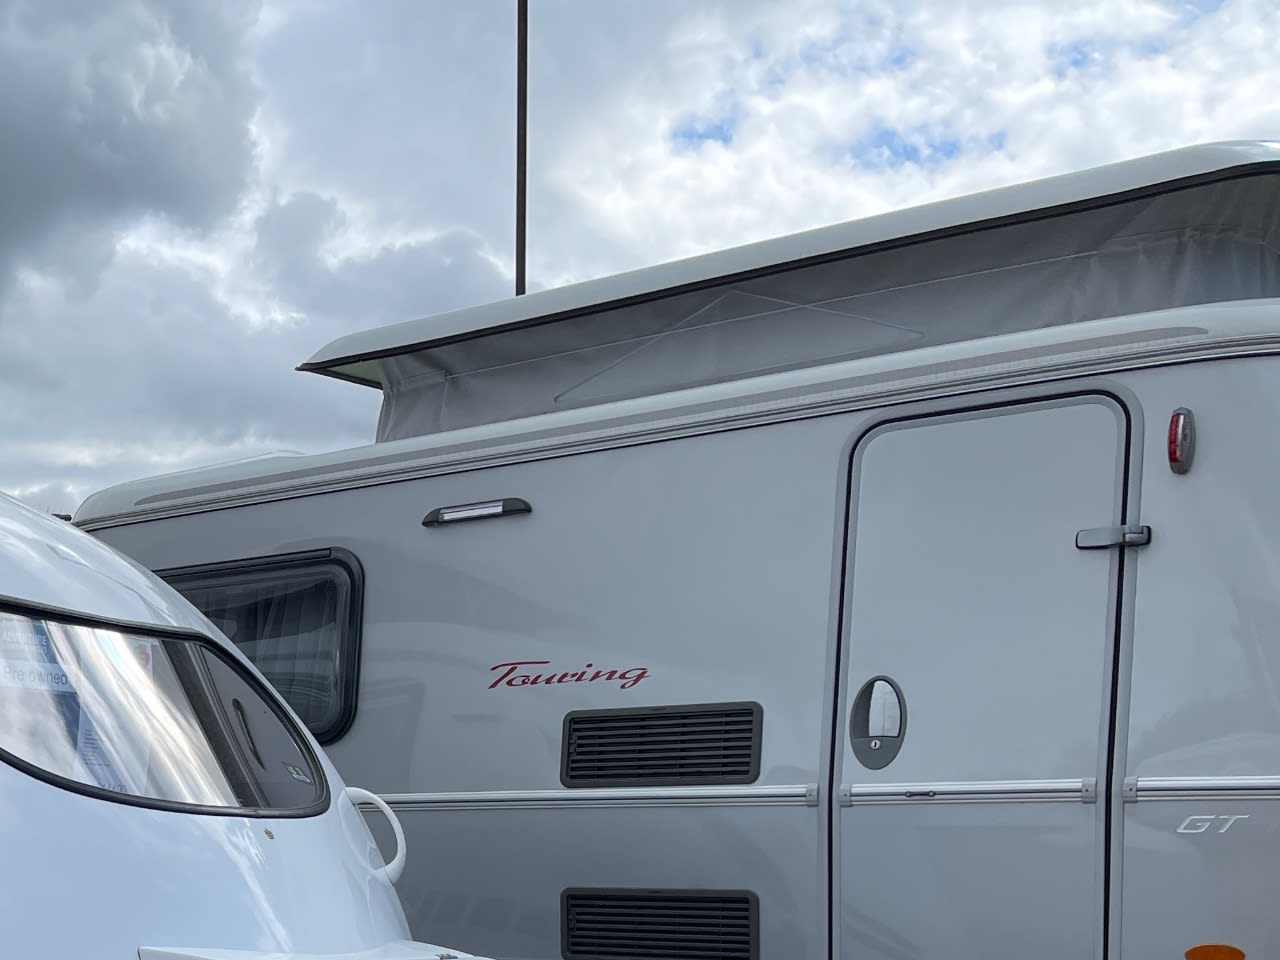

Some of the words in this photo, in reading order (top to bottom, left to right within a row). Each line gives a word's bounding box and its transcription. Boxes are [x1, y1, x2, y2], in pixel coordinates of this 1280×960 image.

[1, 631, 48, 646] ADVENTURE
[3, 664, 25, 682] Pre
[488, 661, 651, 690] Touring
[1176, 814, 1250, 833] GT
